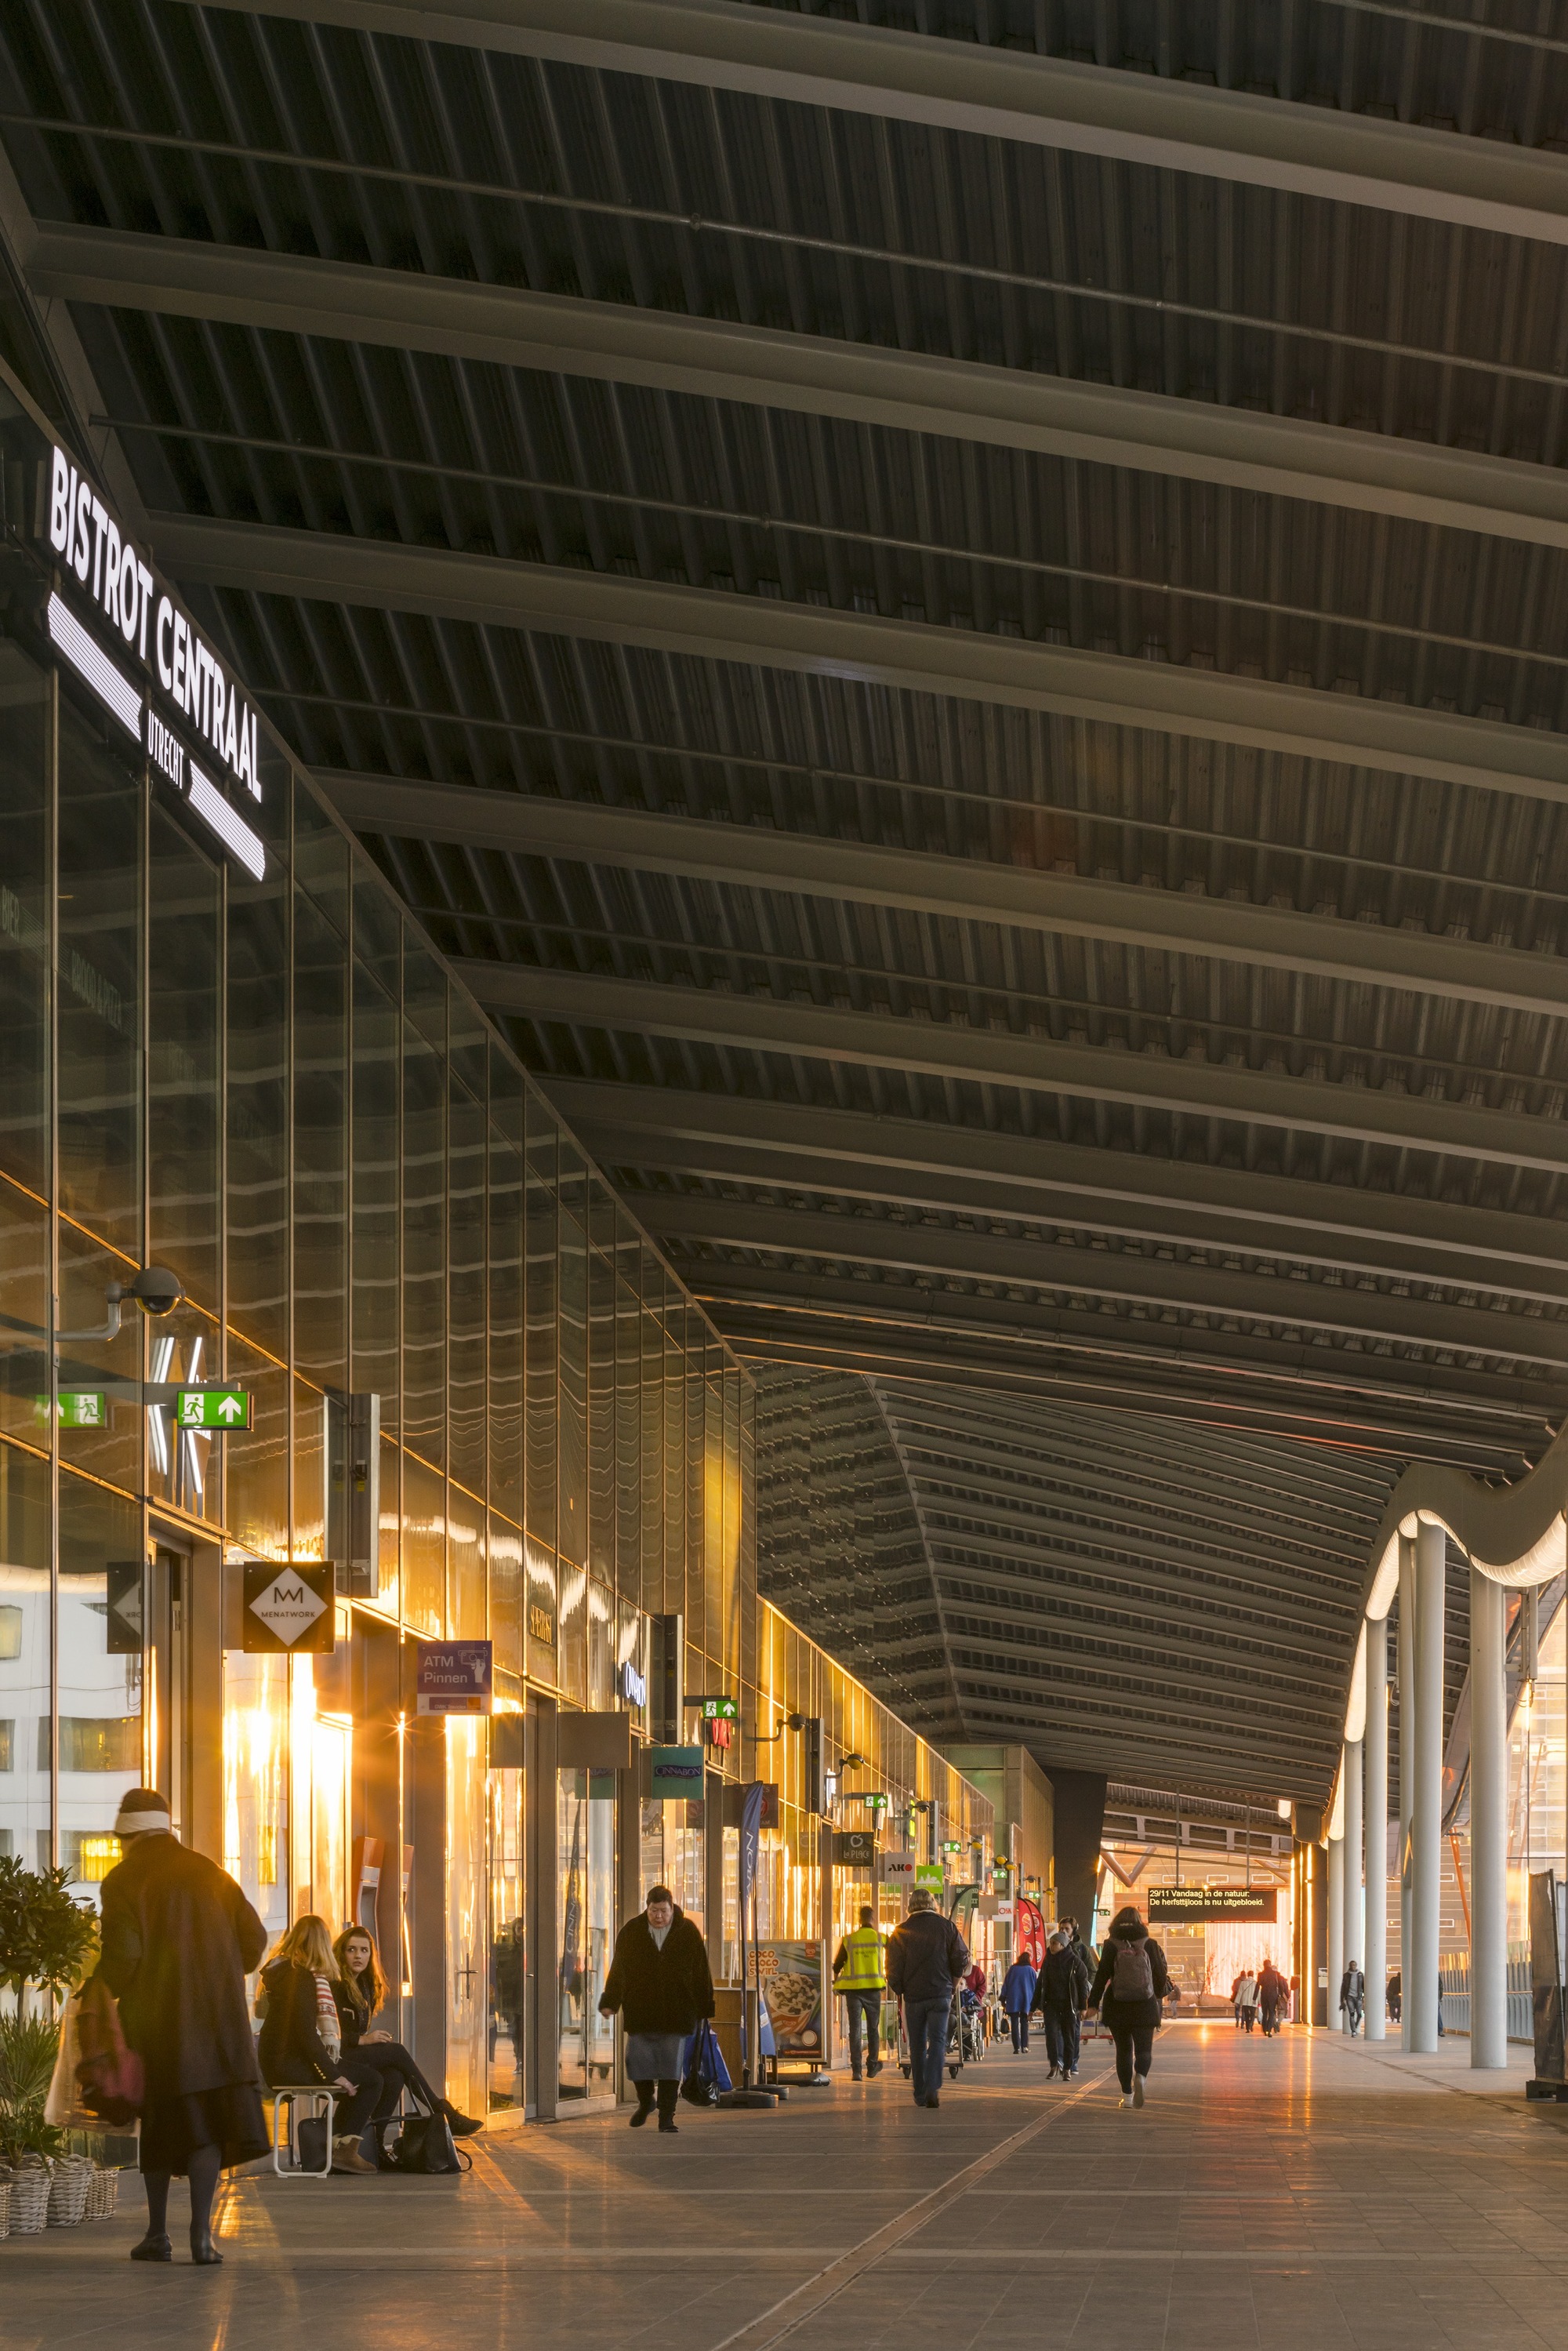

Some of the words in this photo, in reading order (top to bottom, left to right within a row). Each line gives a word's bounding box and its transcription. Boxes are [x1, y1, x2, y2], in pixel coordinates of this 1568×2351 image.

[50, 445, 153, 660] BISTROT
[157, 596, 262, 803] CENTRAAL
[147, 709, 184, 790] UTRECHT
[423, 1655, 454, 1667] ATM
[424, 1672, 468, 1683] Pinnen
[655, 1766, 702, 1776] CINNABON
[851, 1850, 869, 1859] PLACE
[1171, 1890, 1203, 1899] Vandaag
[1162, 1899, 1203, 1907] herfsttijloos
[1224, 1899, 1265, 1907] uitgebloeid.
